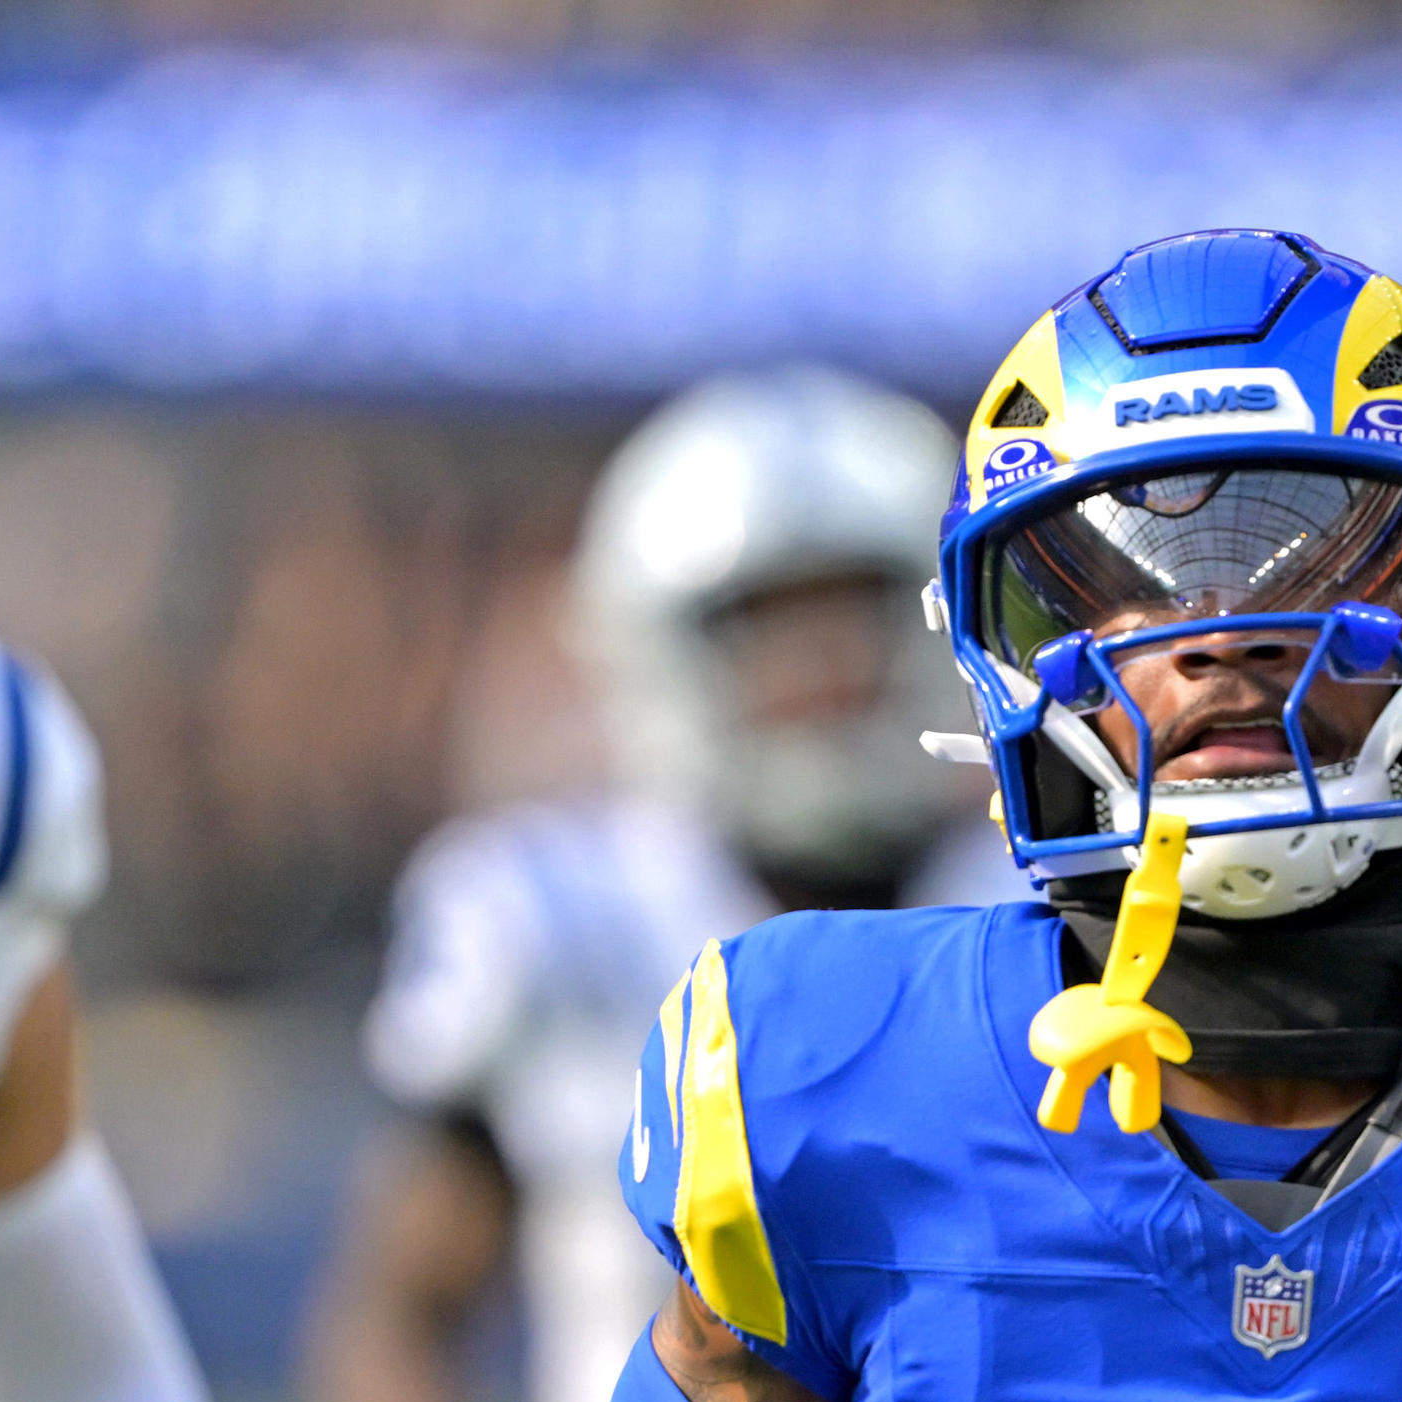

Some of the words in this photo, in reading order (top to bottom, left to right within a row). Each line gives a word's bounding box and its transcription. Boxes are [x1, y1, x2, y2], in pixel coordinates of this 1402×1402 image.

[1114, 384, 1279, 427] RAMS
[985, 460, 1050, 491] OAKLEY
[1246, 1303, 1296, 1340] NFL
